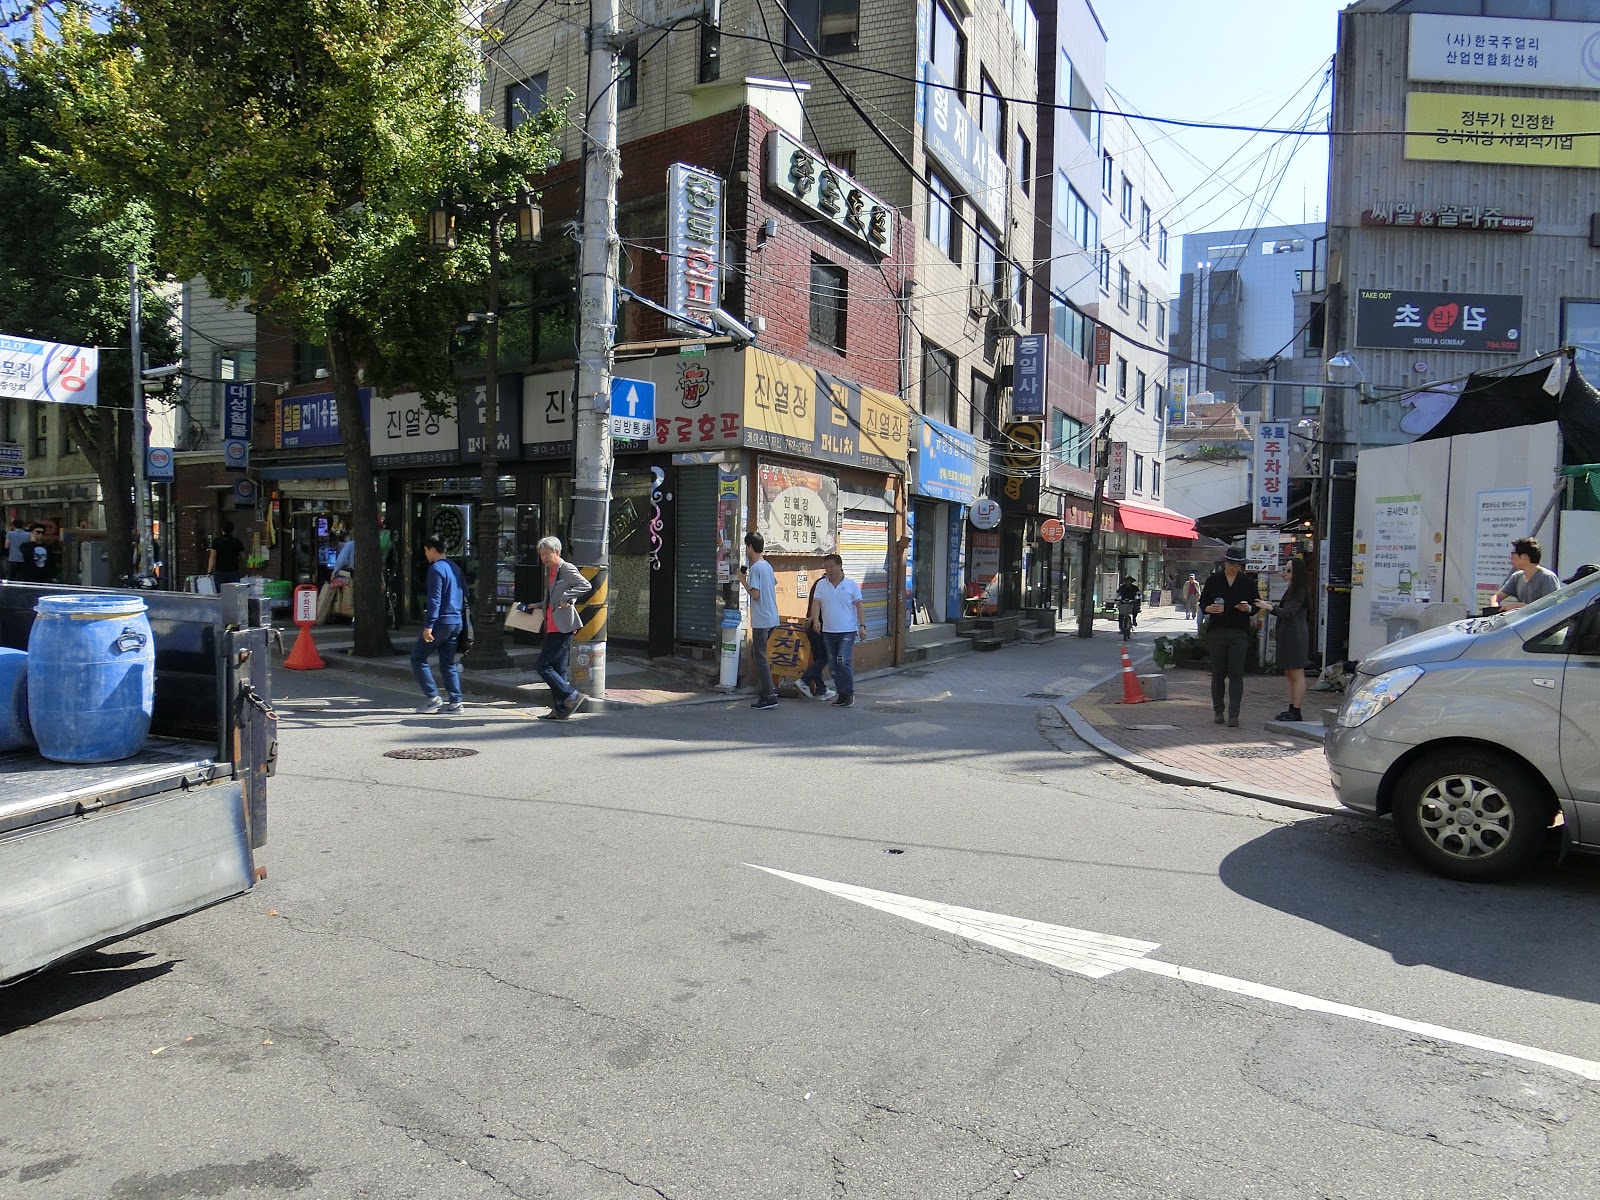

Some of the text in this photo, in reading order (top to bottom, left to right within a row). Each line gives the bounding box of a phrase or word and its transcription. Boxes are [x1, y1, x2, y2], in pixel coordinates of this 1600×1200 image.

[1461, 110, 1555, 130] 정부가 인정한
[1371, 201, 1417, 225] 씨엘
[1361, 291, 1392, 300] TAKE OUT
[1, 361, 32, 379] 모집
[59, 355, 90, 392] 강
[1018, 337, 1039, 395] 동일사
[754, 373, 808, 419] 진열장
[614, 419, 651, 437] 일방통행
[655, 413, 740, 444] 종로호프
[866, 407, 903, 443] 진열장
[1260, 426, 1286, 440] 유료
[821, 433, 853, 456] 퍼니처
[1263, 441, 1282, 493] 주차장
[783, 495, 809, 511] 진열장
[1260, 496, 1283, 508] 입구
[783, 529, 817, 544] 제작전문
